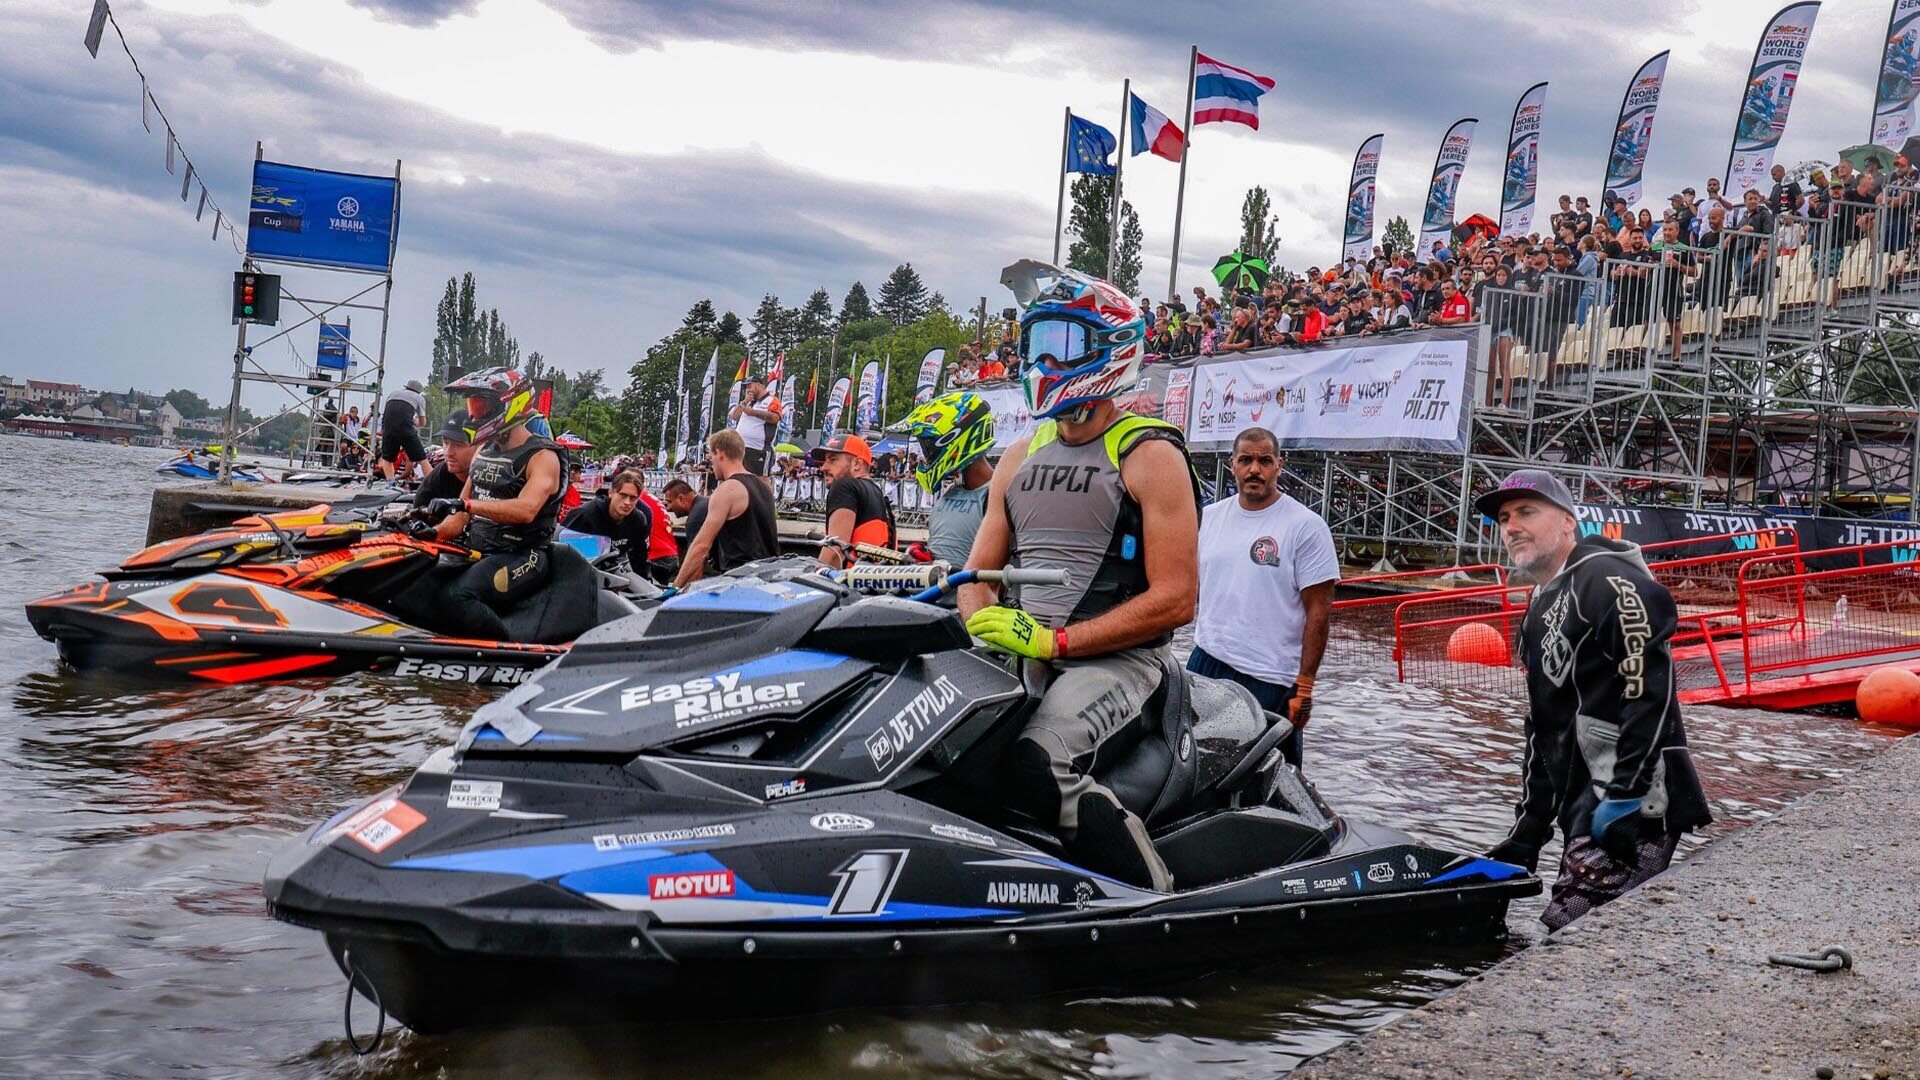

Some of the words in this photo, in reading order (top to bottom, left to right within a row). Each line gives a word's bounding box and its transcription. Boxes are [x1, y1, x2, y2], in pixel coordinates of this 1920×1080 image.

[1765, 40, 1805, 49] WORLD
[1762, 48, 1803, 58] SERIES
[1516, 115, 1541, 126] WORLD
[1515, 123, 1540, 134] SERIES
[1443, 146, 1468, 155] WORLD
[1441, 153, 1466, 162] SERIES
[263, 216, 282, 228] Cup
[329, 218, 365, 231] YAMAHA
[1358, 381, 1392, 400] VICHY
[1412, 379, 1446, 399] JET
[1286, 387, 1306, 405] THAI
[1362, 405, 1383, 417] SPORT
[1403, 400, 1450, 421] PILOT
[1219, 411, 1237, 424] NSDF
[483, 462, 504, 475] JET
[472, 470, 502, 483] PILOT
[1021, 464, 1100, 494] JTPLT
[853, 578, 926, 590] RENTHAL
[394, 657, 488, 684] Easy
[620, 671, 741, 712] Easy
[674, 681, 805, 721] Rider
[677, 709, 743, 729] RACING
[747, 700, 804, 715] PARTS
[889, 674, 963, 753] JETPILOT
[619, 828, 693, 846] THERMO
[693, 823, 736, 839] KING
[1402, 872, 1432, 880] ZAPATA
[654, 874, 731, 897] MOTUL
[828, 848, 910, 918] 1
[1313, 877, 1348, 889] SATRANS
[987, 882, 1060, 905] AUDEMAR
